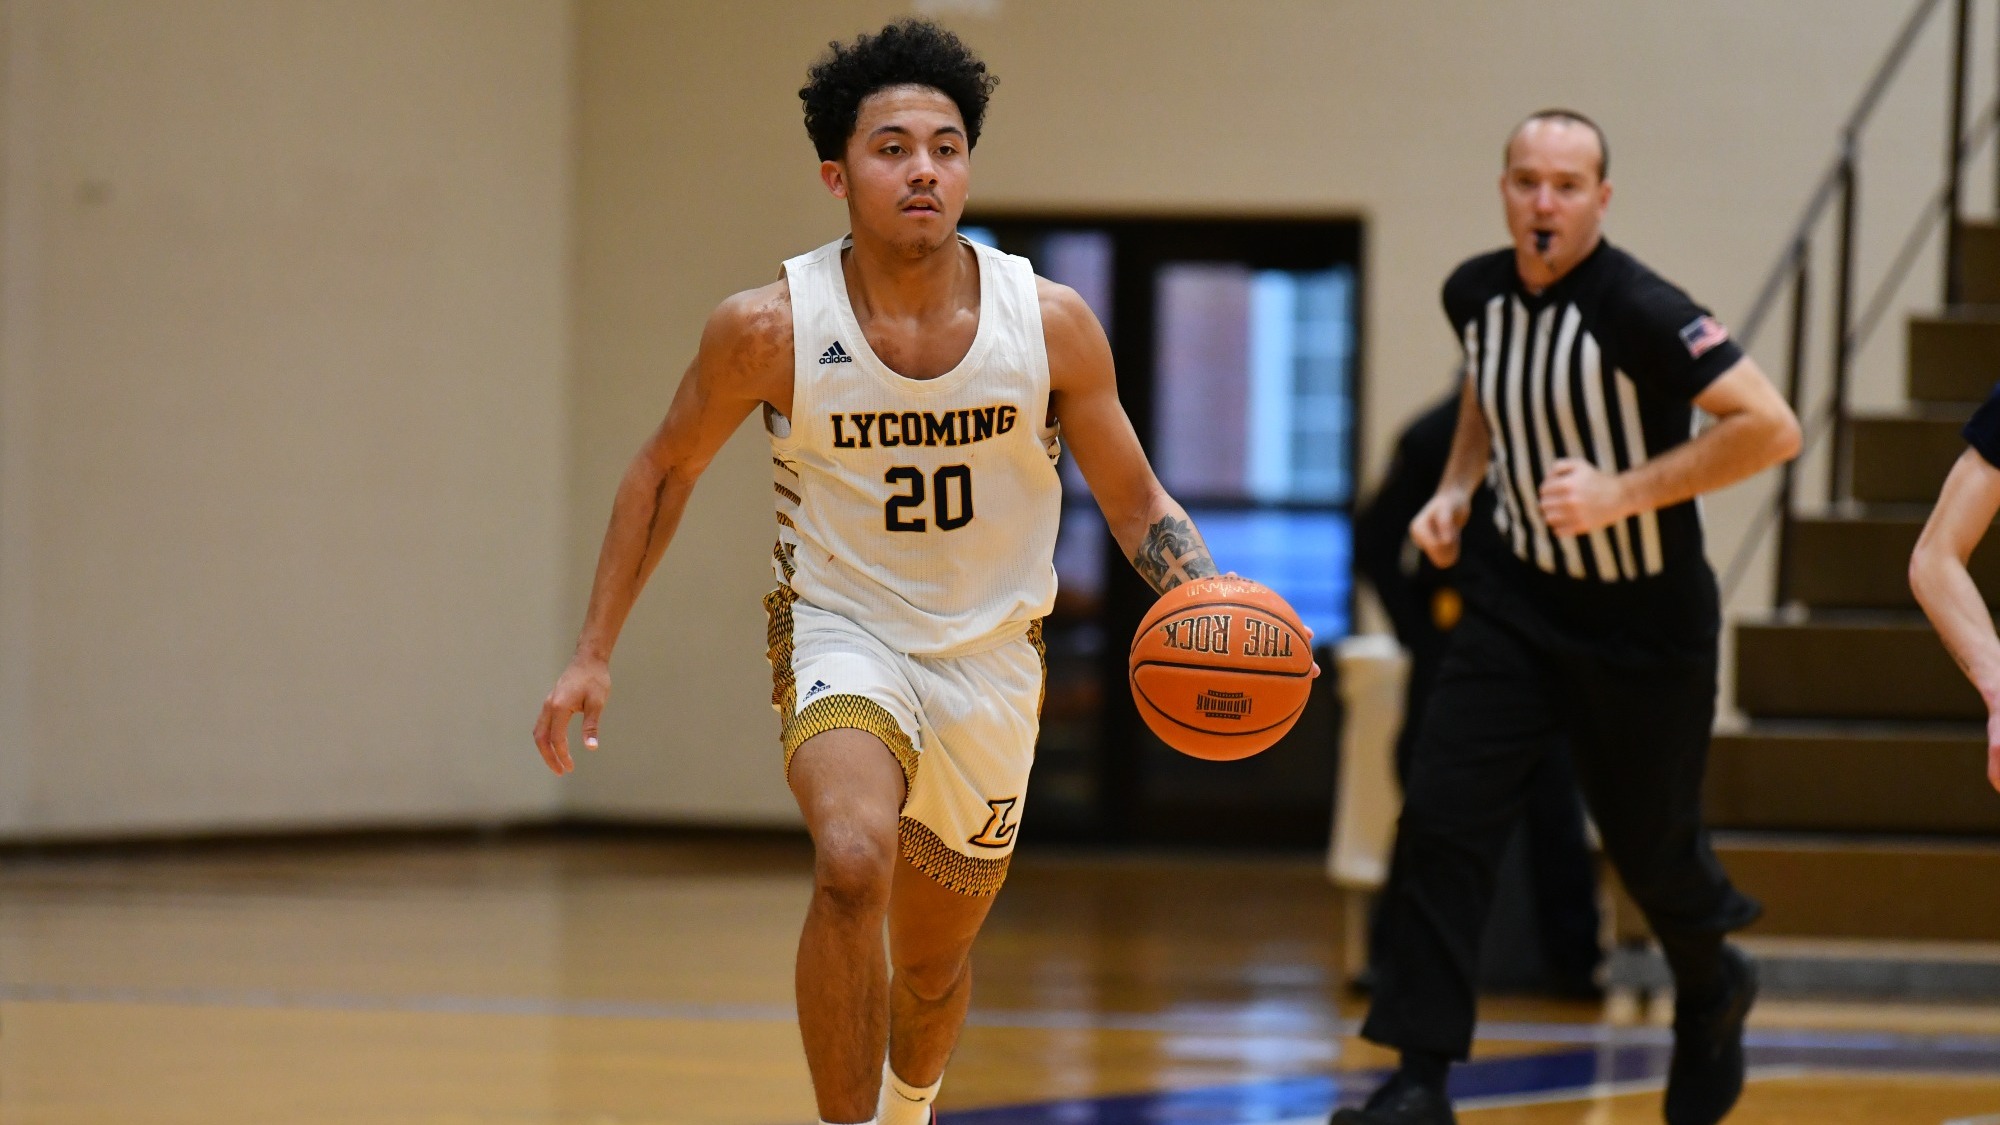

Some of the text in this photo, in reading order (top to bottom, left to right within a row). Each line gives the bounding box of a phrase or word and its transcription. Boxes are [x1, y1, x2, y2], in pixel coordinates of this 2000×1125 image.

[819, 354, 852, 365] adidas
[830, 404, 1017, 448] LYCOMING
[883, 463, 974, 533] 20
[1162, 615, 1293, 657] THE ROCK
[1196, 693, 1252, 715] LANDMARK
[967, 796, 1018, 848] L
